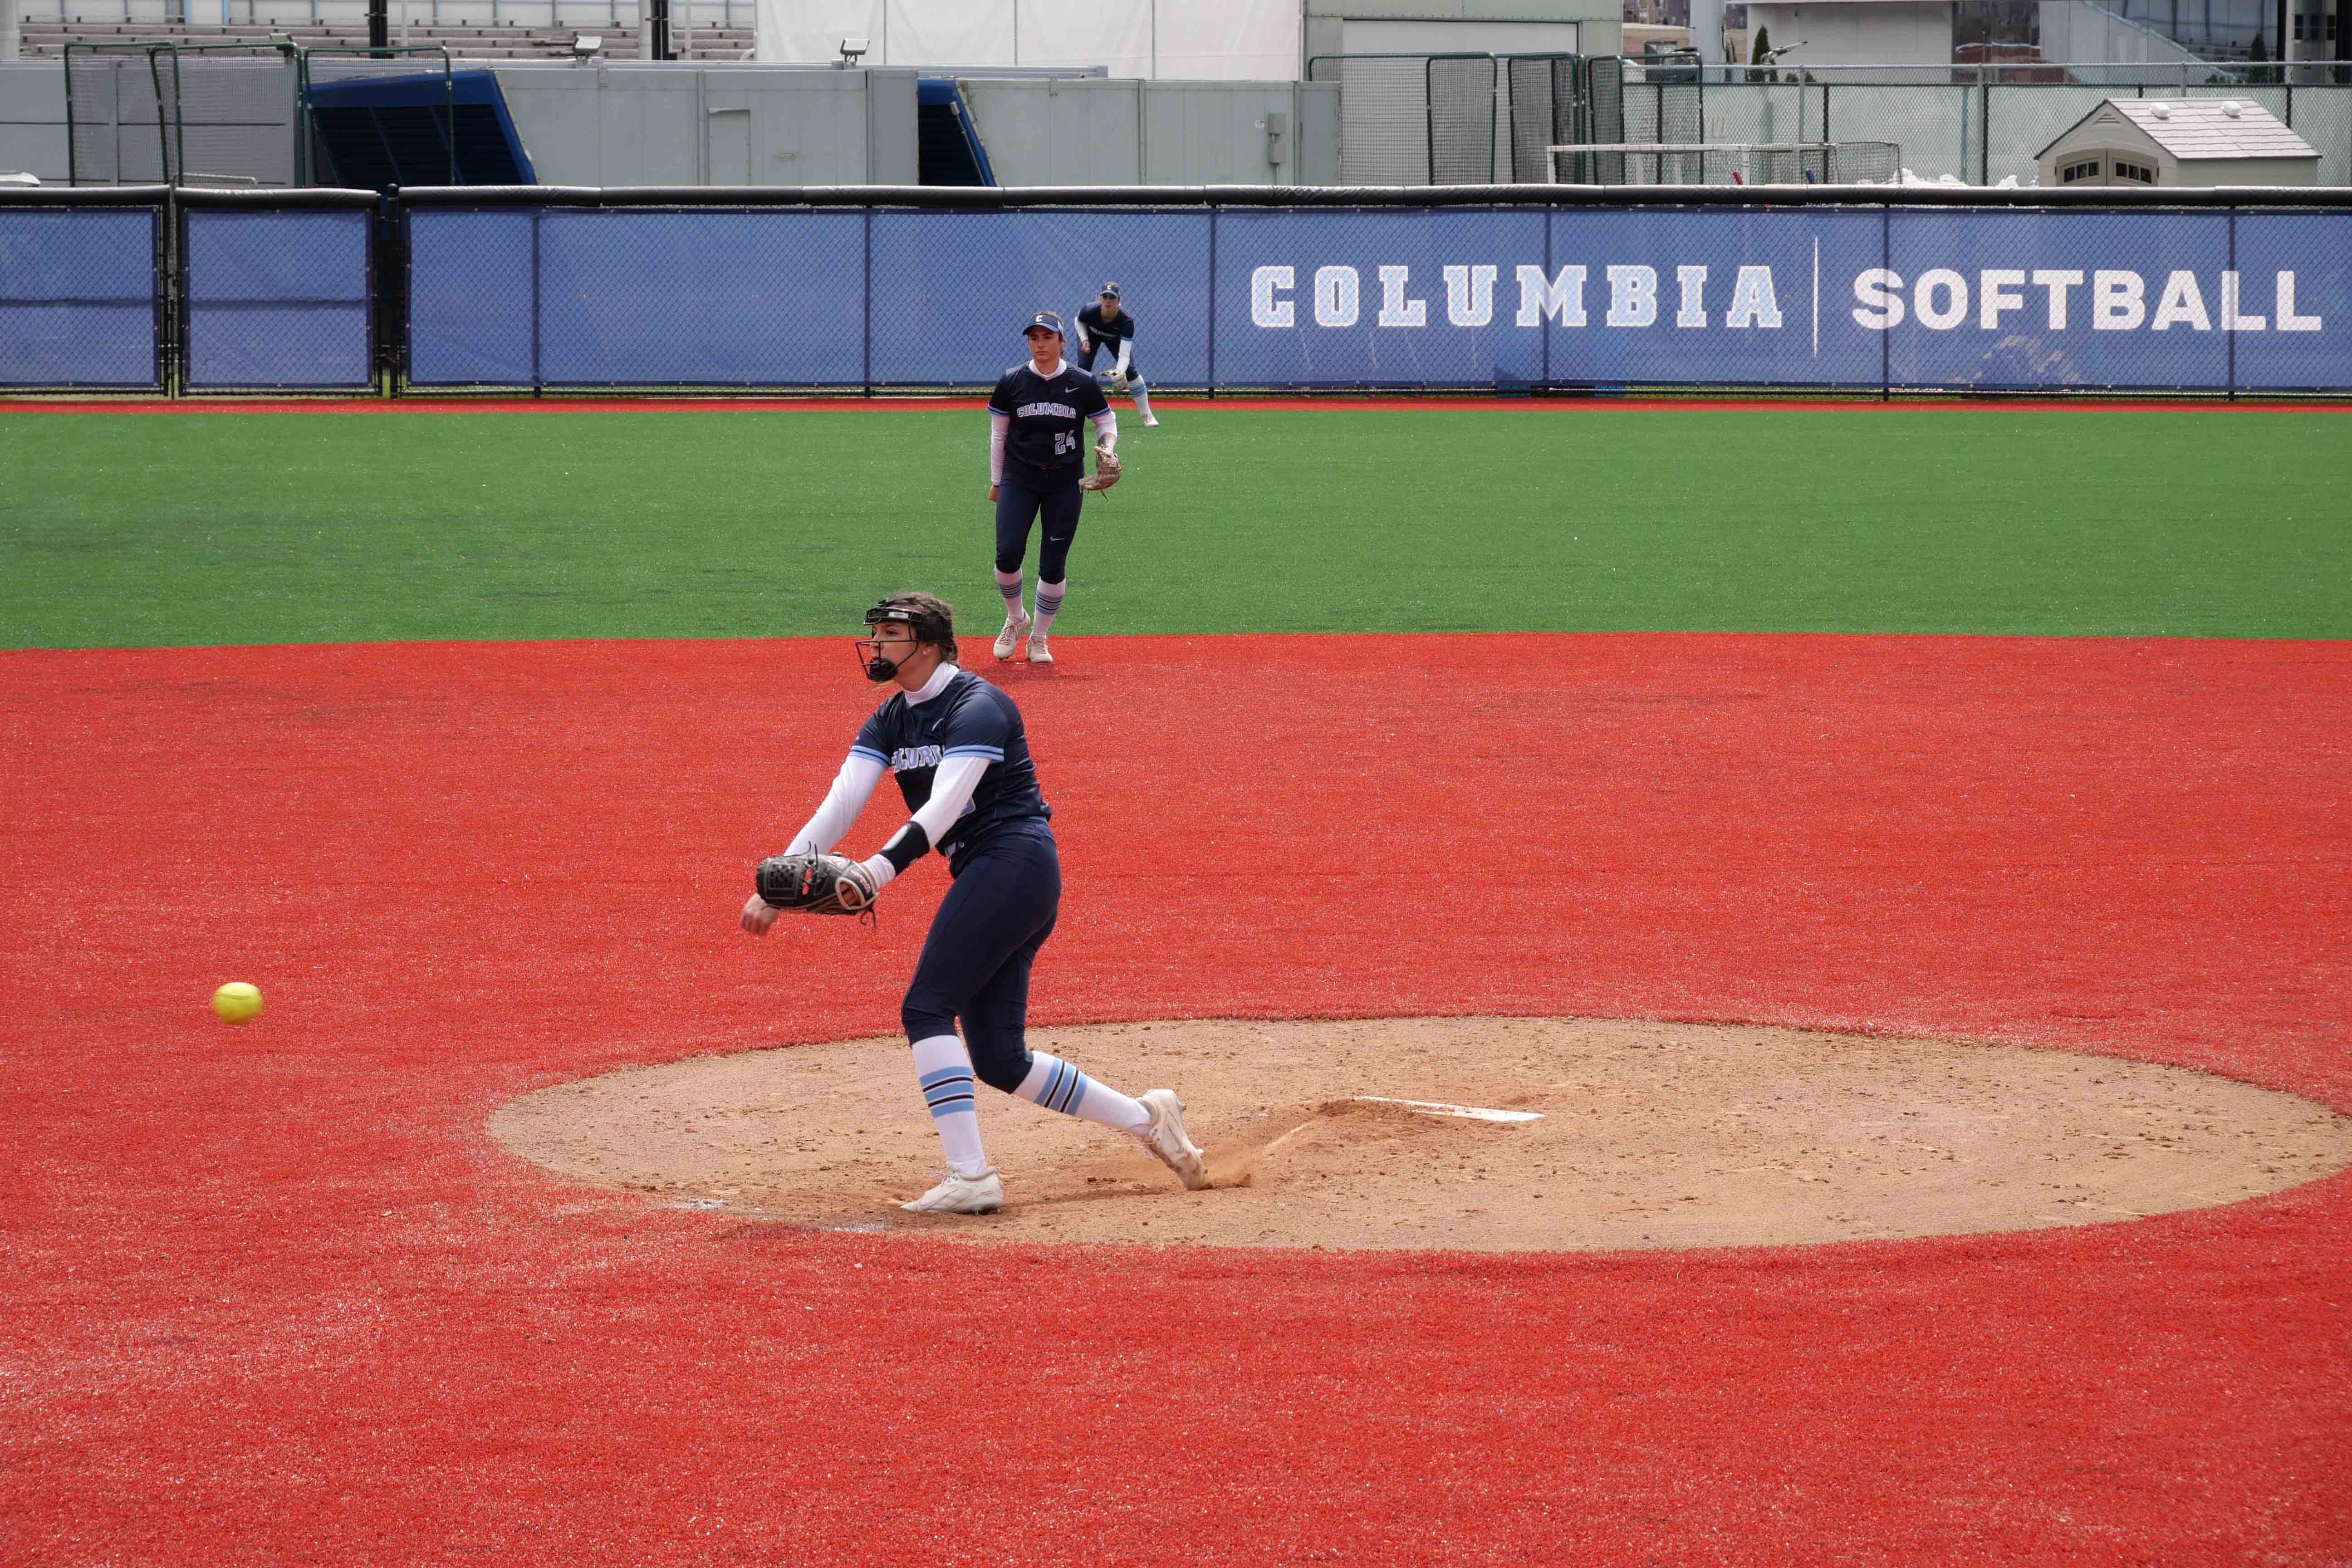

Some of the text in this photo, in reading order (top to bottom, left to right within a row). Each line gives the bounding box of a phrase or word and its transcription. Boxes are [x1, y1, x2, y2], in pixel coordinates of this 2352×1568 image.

[1251, 265, 2323, 331] COLUMBIA SOFTBALL
[1017, 402, 1076, 418] COLUMBIA
[1055, 429, 1076, 455] 24
